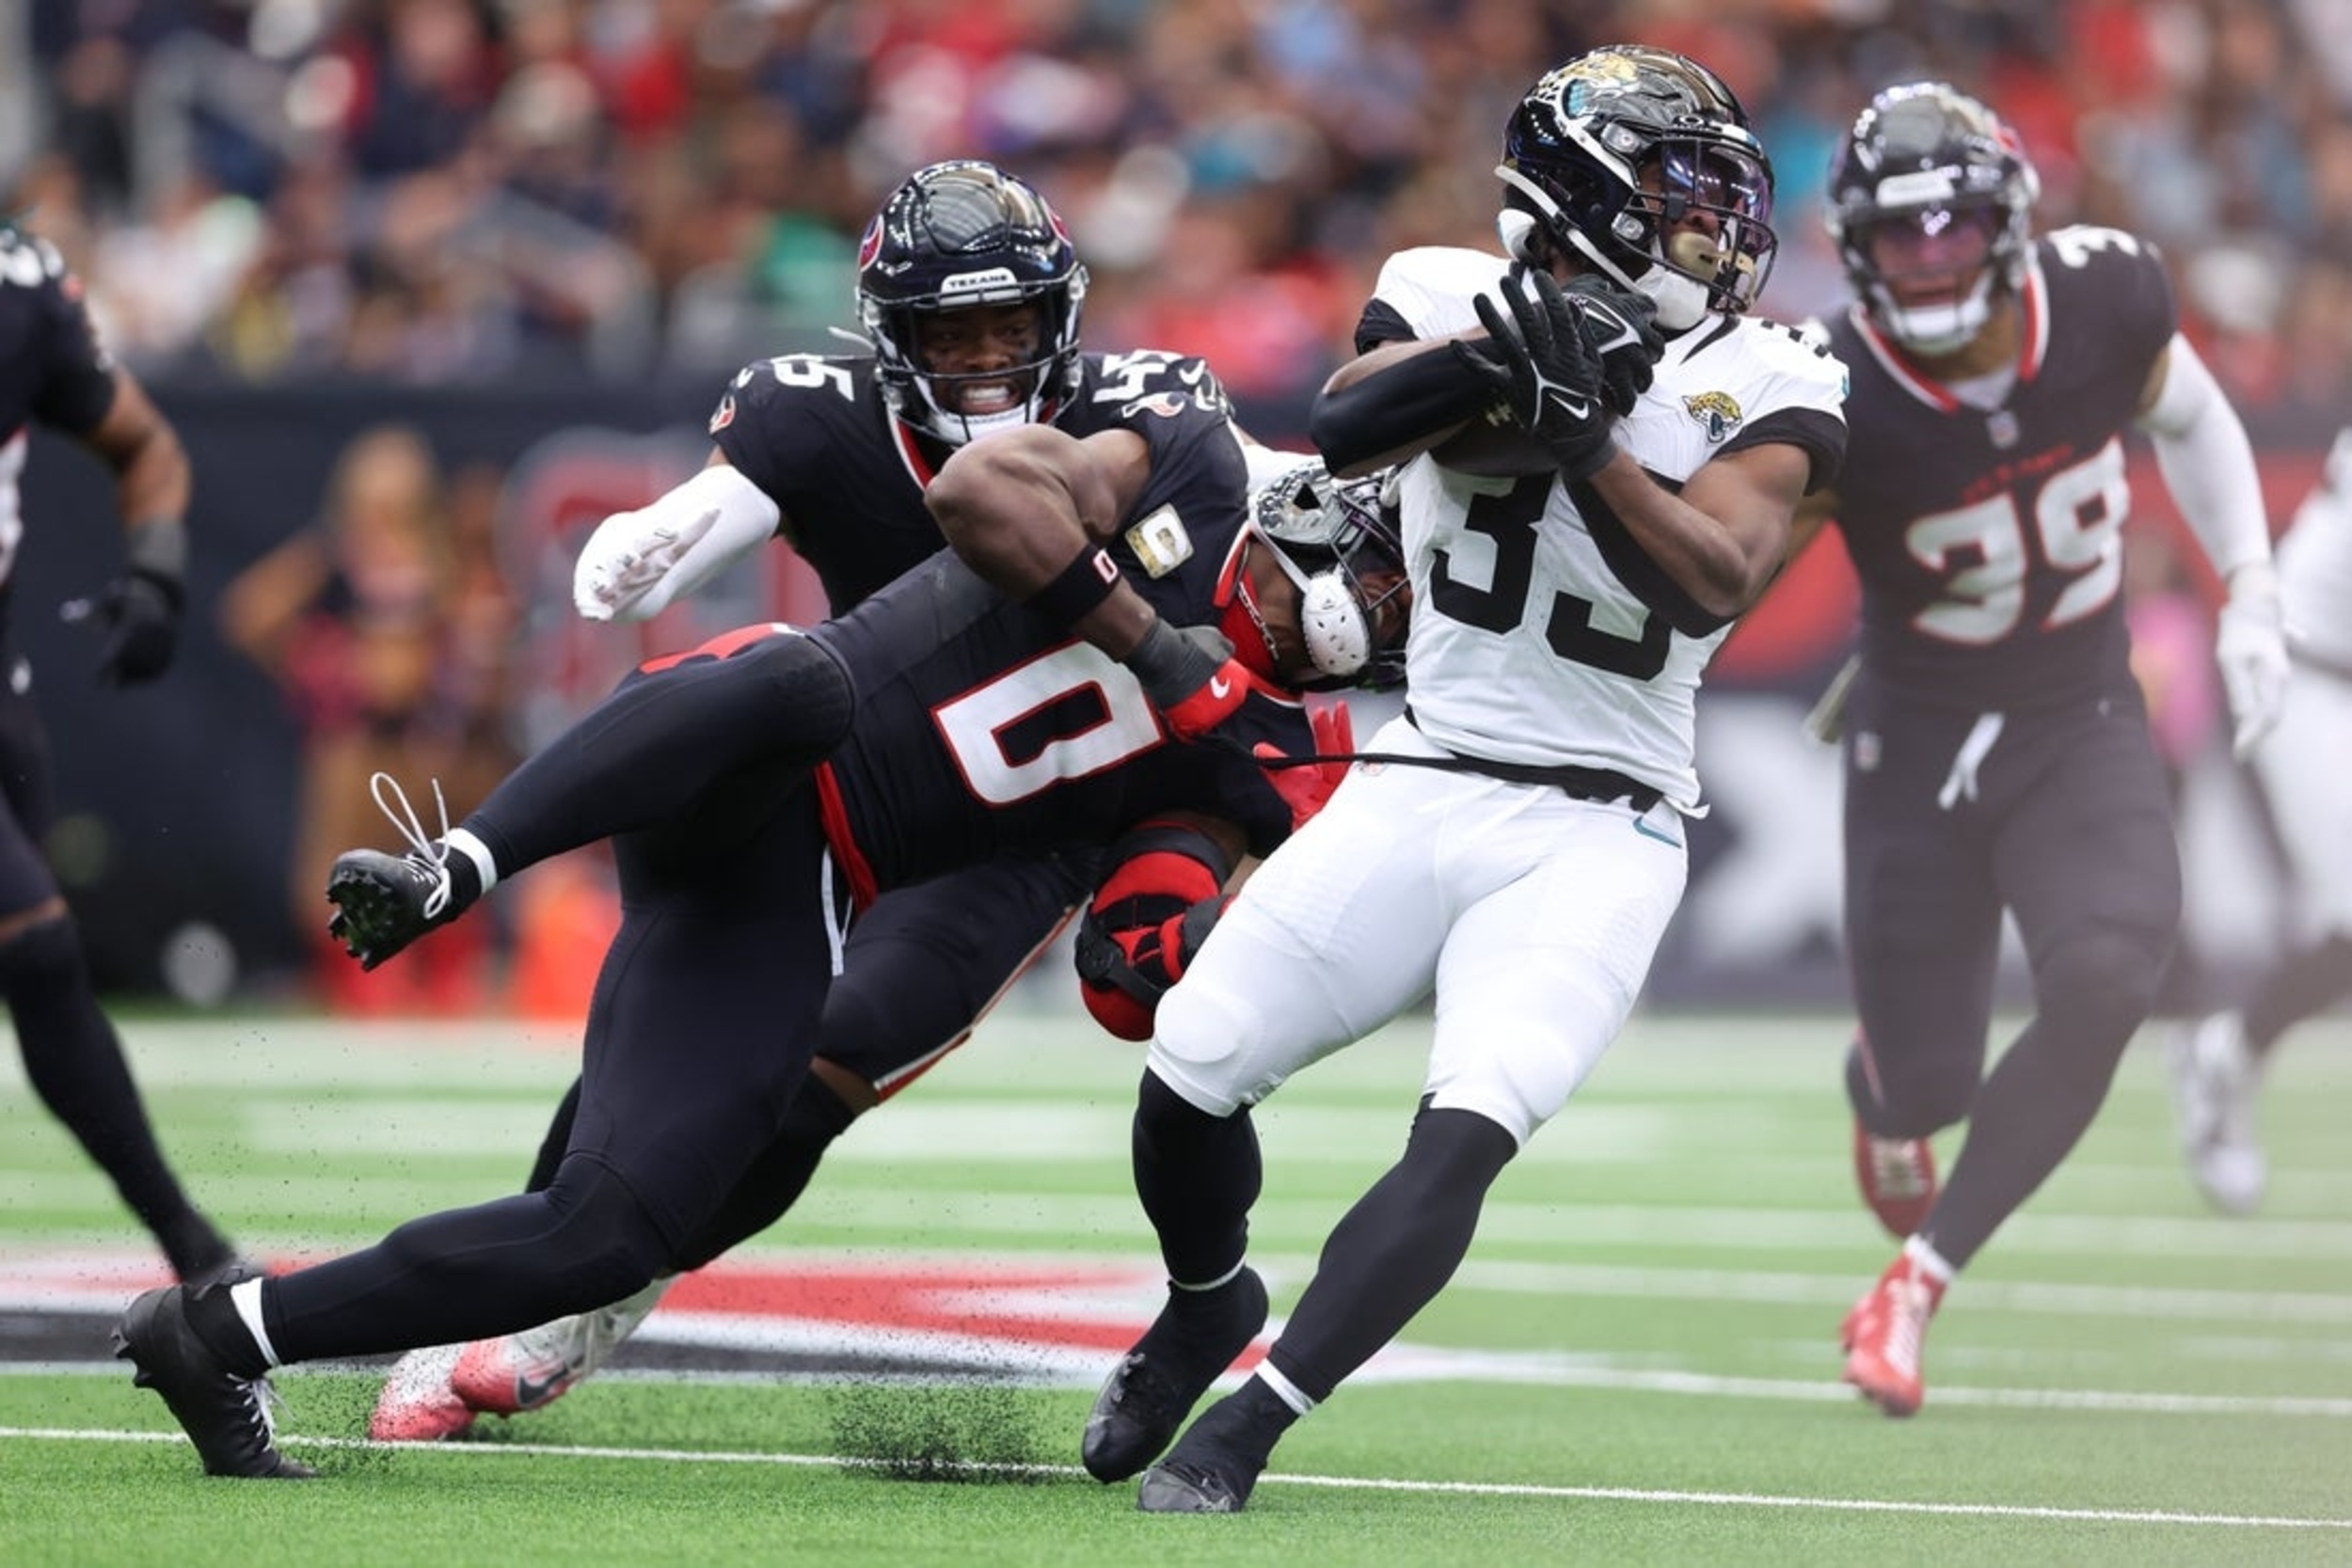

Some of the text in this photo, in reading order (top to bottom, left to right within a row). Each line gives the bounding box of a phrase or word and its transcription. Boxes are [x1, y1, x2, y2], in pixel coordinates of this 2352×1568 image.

[946, 274, 1008, 289] TEXANS
[1905, 436, 2130, 645] 39
[930, 640, 1166, 809] 0
